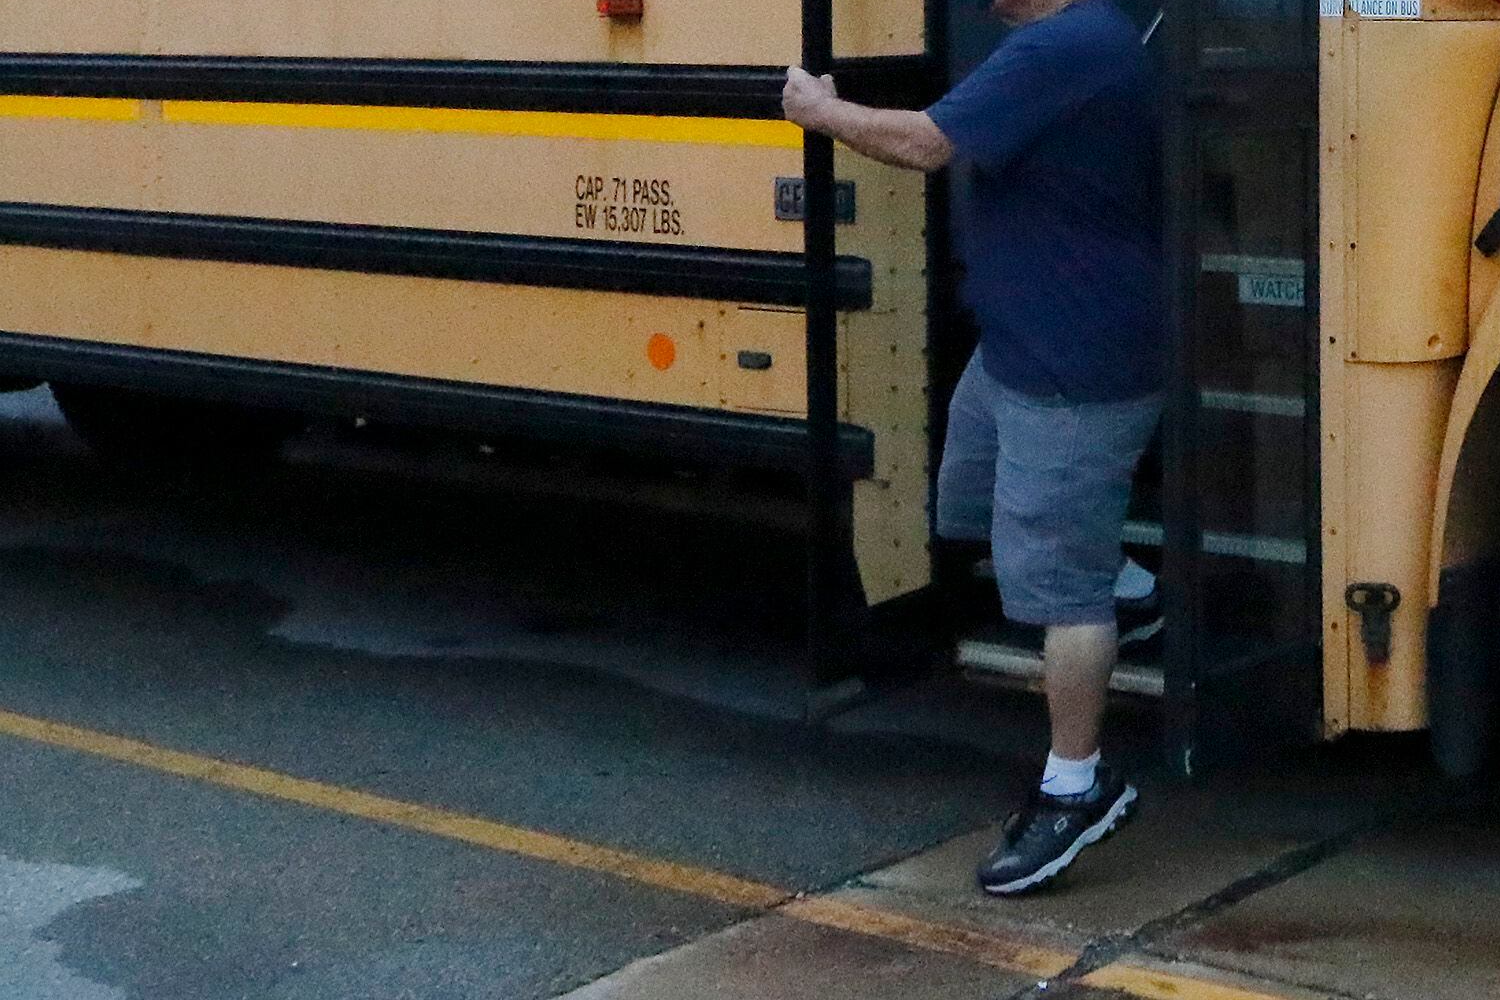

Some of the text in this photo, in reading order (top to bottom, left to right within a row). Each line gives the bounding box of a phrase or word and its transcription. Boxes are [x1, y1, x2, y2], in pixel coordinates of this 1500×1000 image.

[1385, 1, 1398, 15] ON
[1400, 1, 1418, 16] BUS
[576, 175, 674, 207] CAP. 71 PASS.
[575, 203, 685, 236] EW 15,307 LBS.
